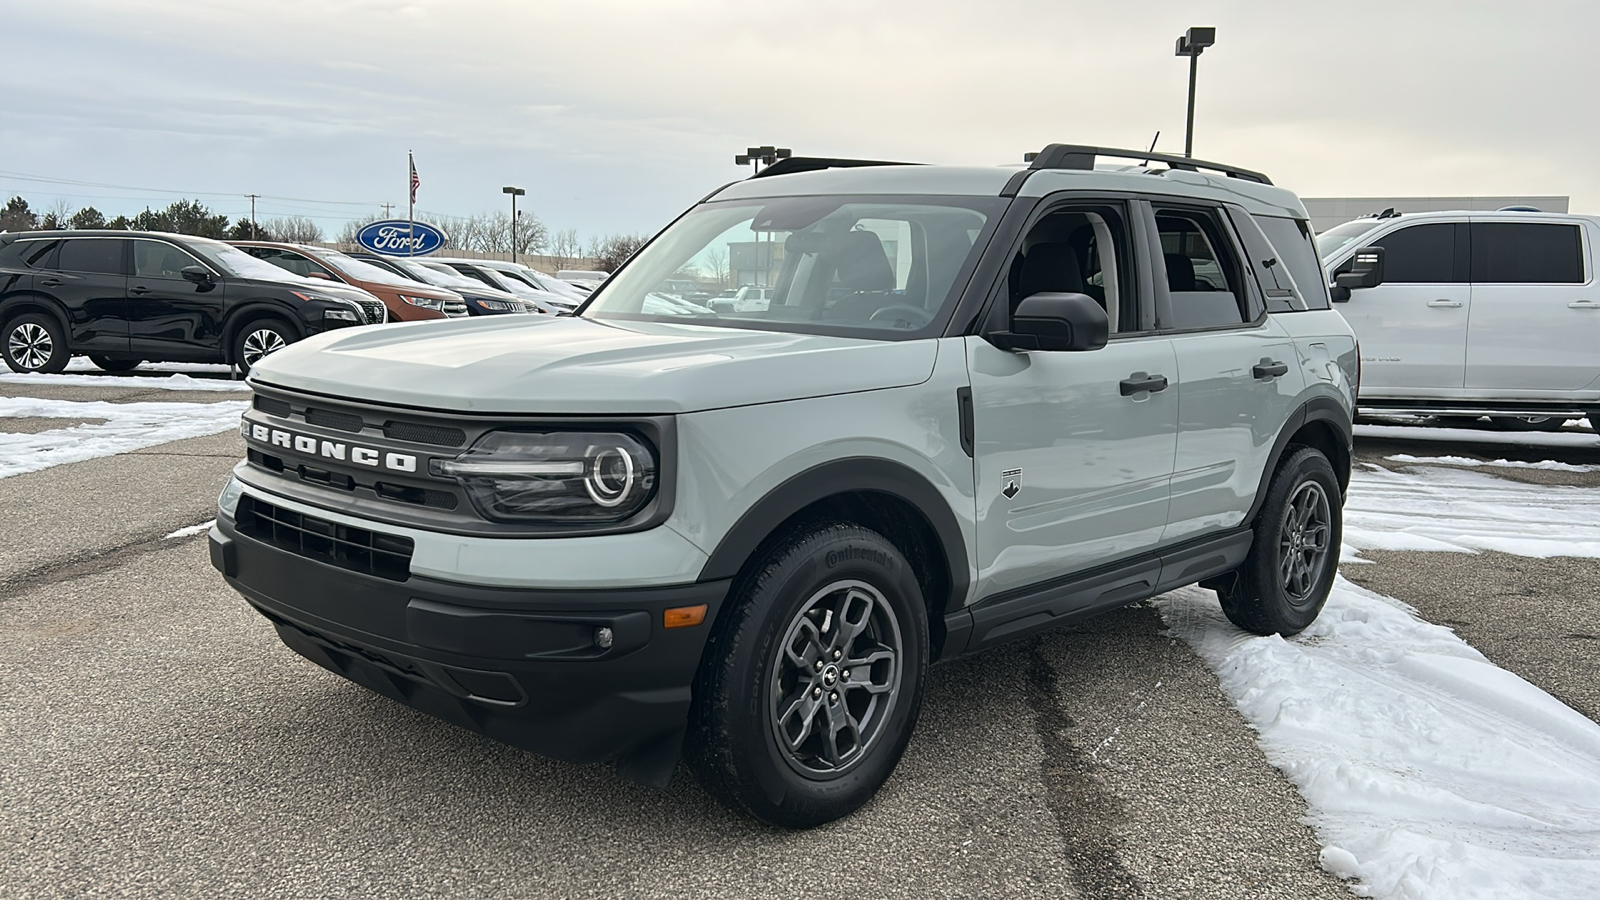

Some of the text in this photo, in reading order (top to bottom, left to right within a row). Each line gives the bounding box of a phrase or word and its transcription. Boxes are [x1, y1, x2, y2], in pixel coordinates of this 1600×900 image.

[373, 226, 426, 250] Ford
[252, 424, 417, 473] BRONCO
[825, 545, 888, 569] Continental
